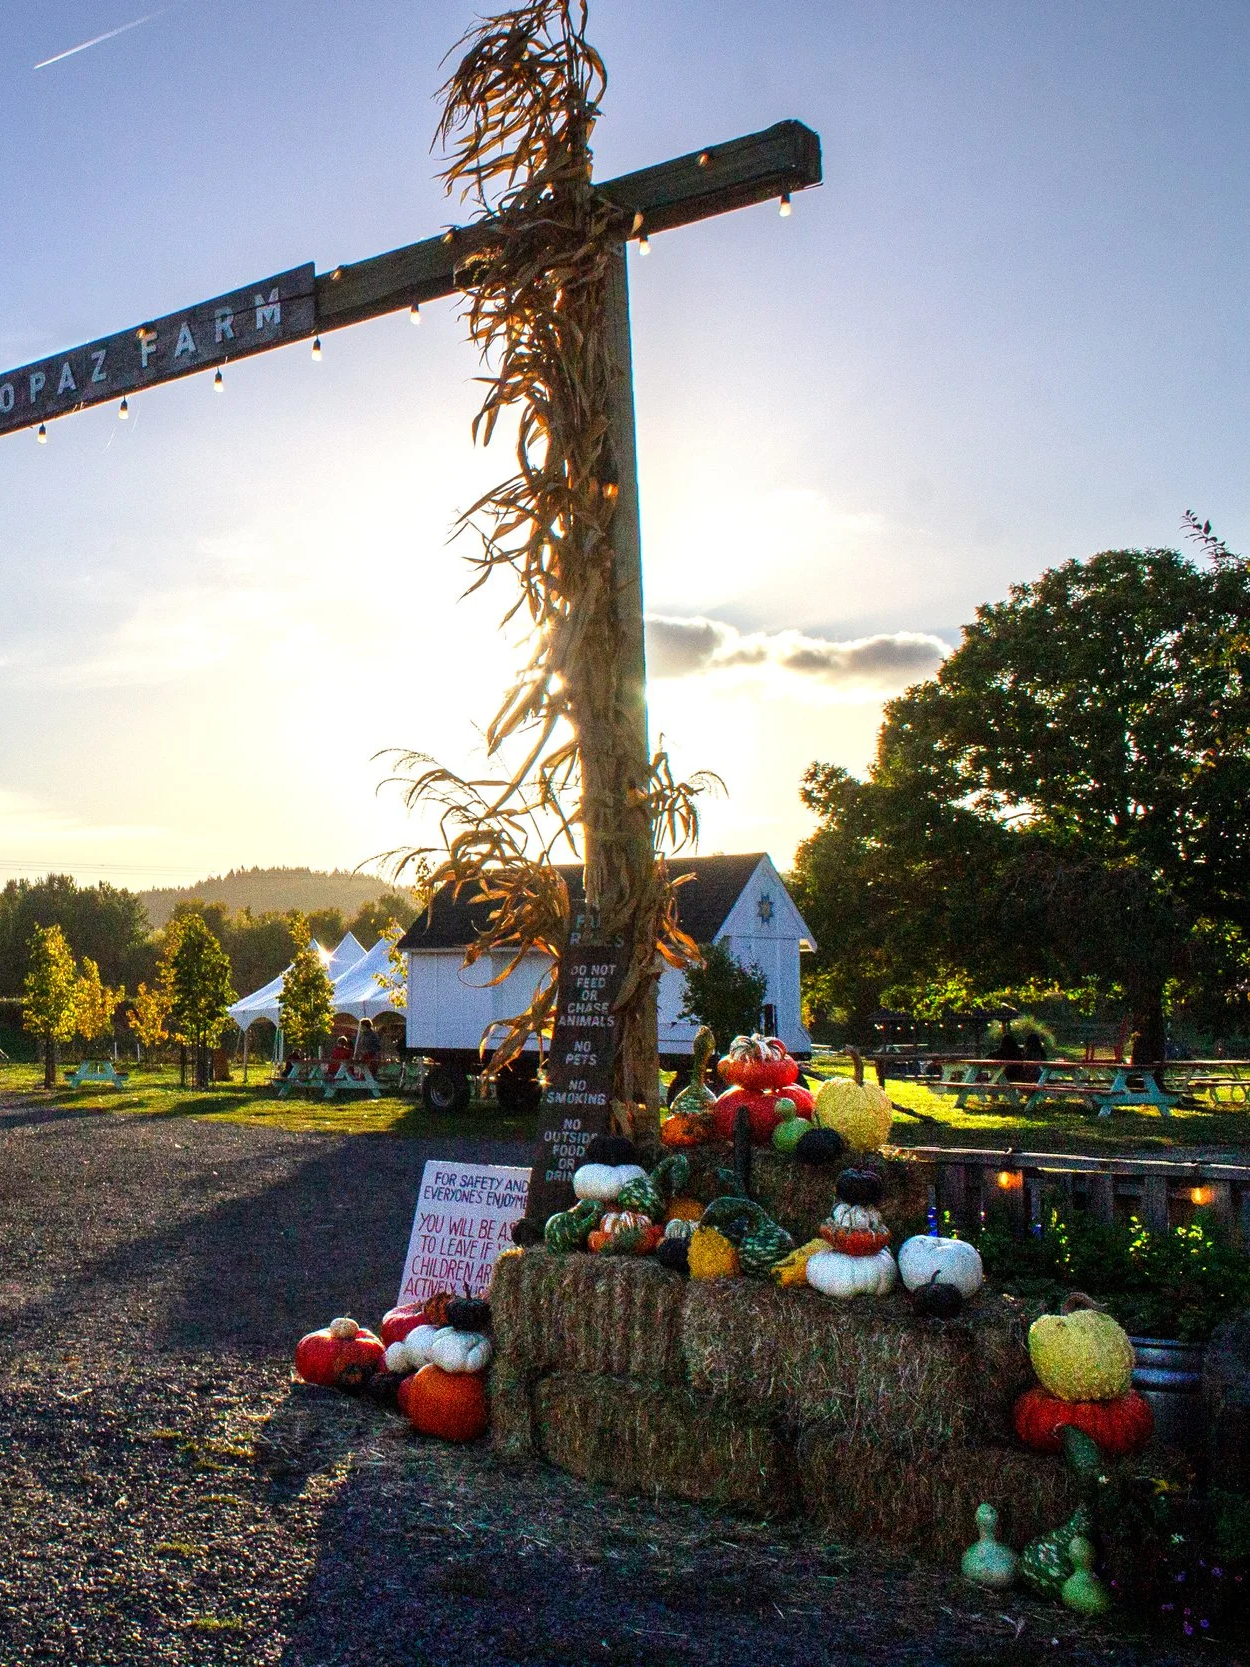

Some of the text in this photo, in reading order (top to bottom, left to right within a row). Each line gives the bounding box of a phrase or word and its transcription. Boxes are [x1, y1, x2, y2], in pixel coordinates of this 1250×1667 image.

[140, 287, 282, 368] FARM
[570, 964, 617, 976] DO NOT
[576, 977, 606, 989] FEED
[581, 989, 598, 1001] OR
[567, 1002, 610, 1014] CHASE
[558, 1015, 615, 1027] ANIMALS
[574, 1041, 591, 1053] NO
[565, 1053, 598, 1066] PETS
[569, 1080, 587, 1092] NO
[546, 1091, 607, 1105] SMOKING
[563, 1118, 582, 1131] NO
[552, 1144, 586, 1157] FOOD
[558, 1158, 575, 1170] OR
[434, 1171, 529, 1194] FOR SAFETY AND
[545, 1170, 575, 1183] DRIN
[485, 1191, 528, 1209] ENJOYME
[418, 1212, 517, 1242] YOU WILL BE AS
[420, 1234, 437, 1254] TO
[439, 1237, 480, 1260] LEAVE
[480, 1241, 494, 1260] IF
[411, 1255, 493, 1284] CHILDREN AR
